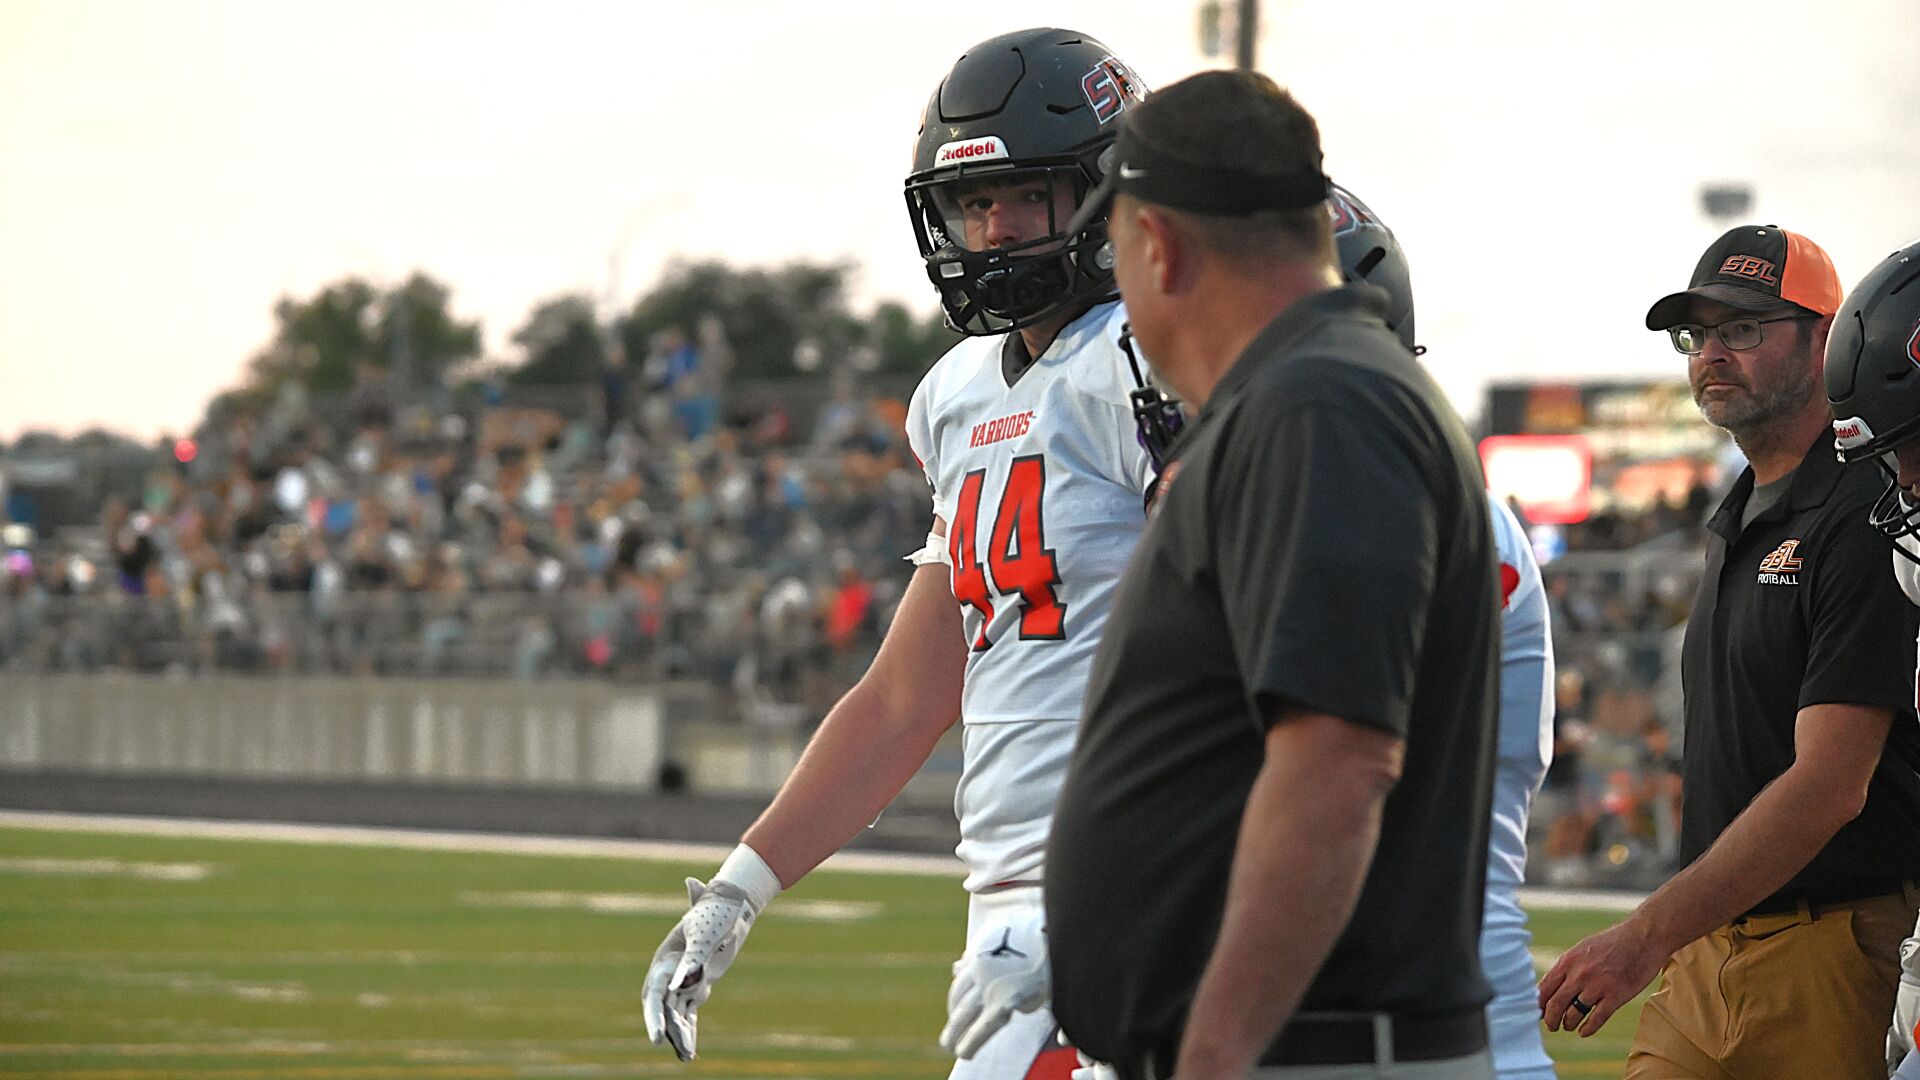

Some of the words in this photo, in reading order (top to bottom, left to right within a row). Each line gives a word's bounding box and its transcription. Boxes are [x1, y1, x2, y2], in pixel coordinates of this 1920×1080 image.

[1718, 254, 1777, 287] SBL
[969, 410, 1035, 449] WARRIORS
[949, 453, 1067, 651] 44
